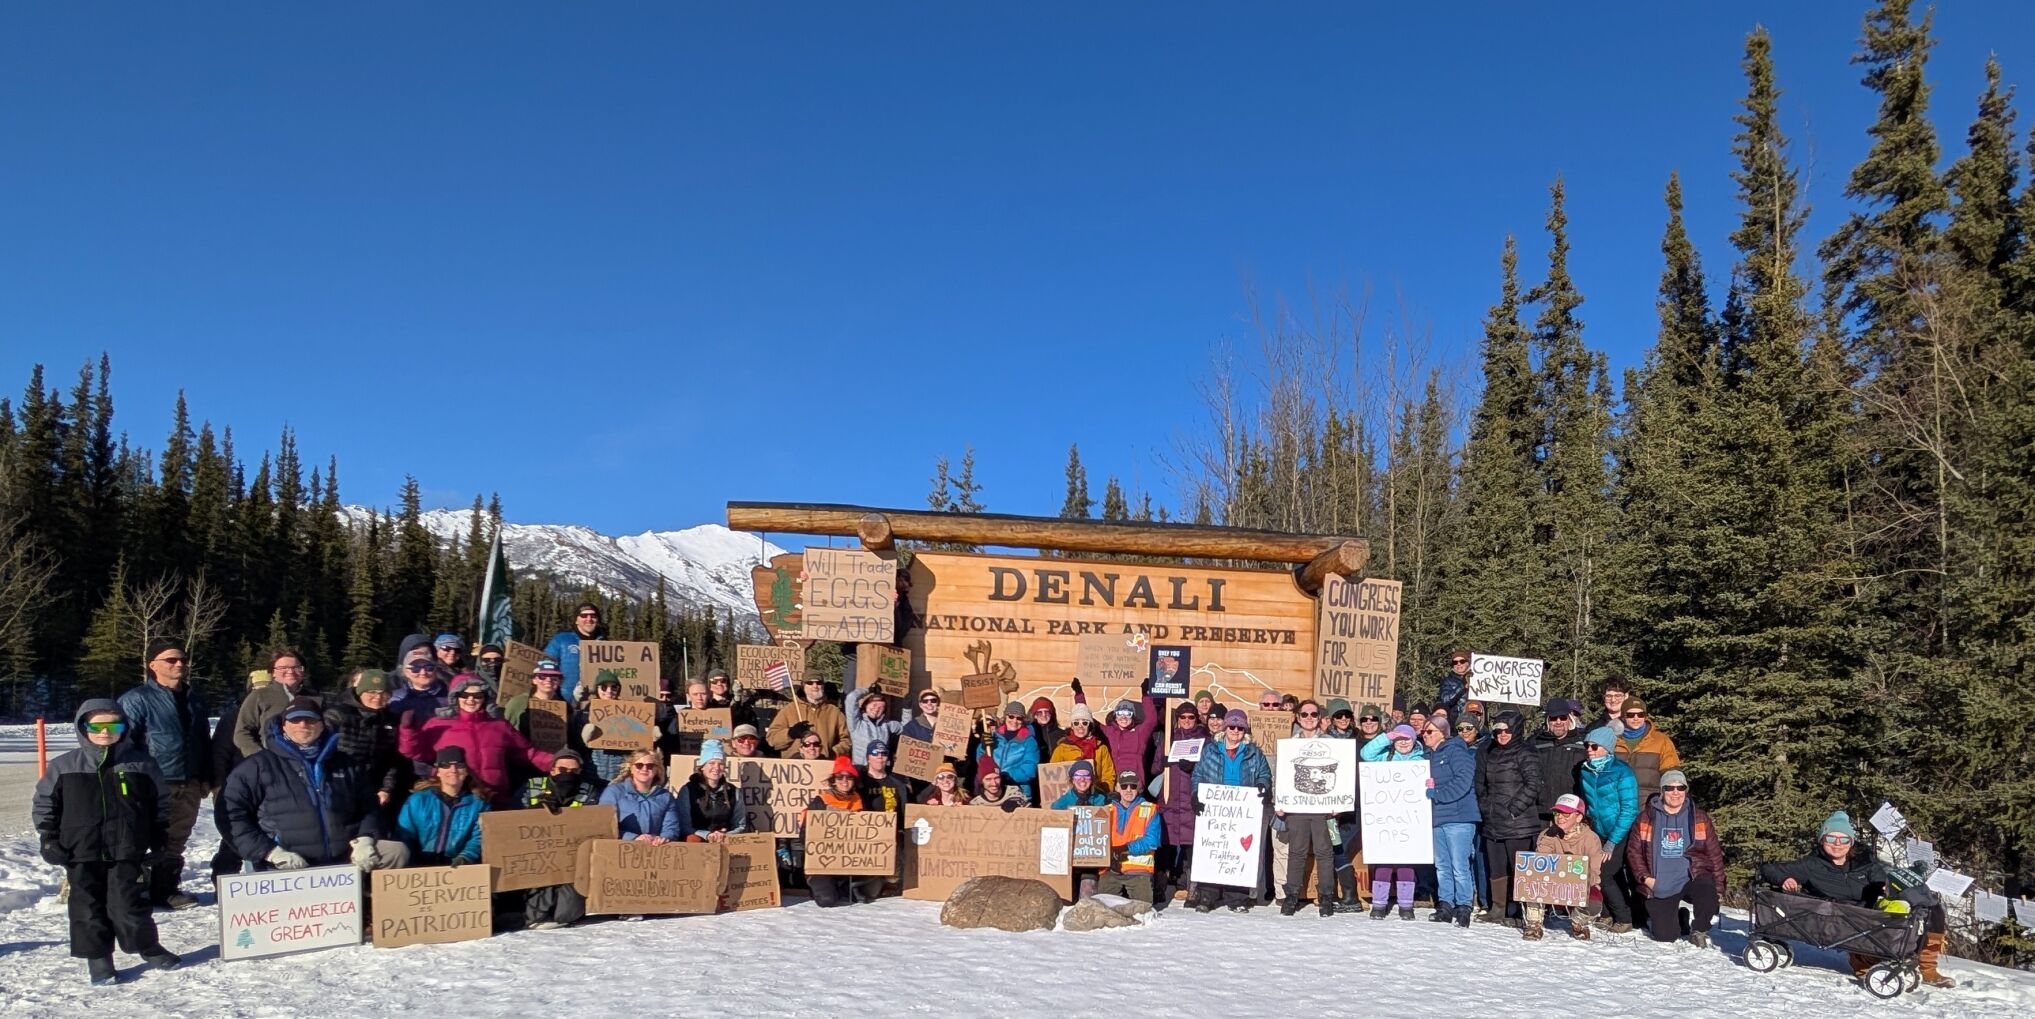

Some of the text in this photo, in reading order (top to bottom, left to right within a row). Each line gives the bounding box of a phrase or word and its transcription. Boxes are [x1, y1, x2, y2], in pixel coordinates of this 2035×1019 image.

[806, 550, 894, 577] Will Trade
[810, 577, 891, 610] EGGS
[988, 566, 1227, 612] DENALI
[1328, 580, 1400, 615] CONGRESS
[807, 614, 836, 639] For
[910, 613, 1297, 646] NATIONAL PARK AND PRESERVE
[1328, 611, 1396, 642] YOU WORK
[587, 645, 653, 663] HUG A
[740, 647, 801, 660] ECOLOGISTS
[1322, 640, 1392, 671] FOR US
[1473, 657, 1542, 677] CONGRESS
[629, 684, 649, 698] YOU
[963, 678, 995, 688] RESIST
[1320, 669, 1388, 698] NOT THE
[1470, 674, 1538, 701] WORKS 4 US
[593, 704, 654, 725] DENALI
[680, 712, 723, 728] Yesterday
[601, 740, 640, 748] FOREVER
[909, 748, 931, 760] DIES
[759, 762, 814, 786] LANDS
[904, 765, 926, 776] DOGE
[1375, 767, 1406, 784] We
[1206, 788, 1249, 802] DENALI
[1276, 794, 1354, 806] WE STAND WITH NPS
[811, 812, 896, 828] MOVE SLOW
[939, 811, 1039, 835] ONLY YOU
[1364, 808, 1421, 826] Denali
[518, 824, 567, 840] DON'T
[824, 827, 879, 841] BUILD
[1078, 834, 1109, 846] out of
[536, 838, 582, 850] BREAK
[806, 841, 893, 856] COMMUNITY
[937, 838, 968, 858] CAN
[976, 839, 1040, 858] PREVENT
[502, 850, 561, 876] FIX
[619, 843, 689, 871] POWER
[841, 855, 887, 868] DENALI
[1515, 852, 1562, 874] JOY
[643, 871, 658, 880] IN
[986, 861, 1038, 878] FIRES
[229, 873, 355, 898] PUBLIC LANDS
[383, 870, 454, 892] PUBLIC
[602, 877, 703, 899] COMMUNITY
[408, 885, 489, 907] SERVICE
[229, 901, 356, 929] MAKE AMERICA
[381, 910, 489, 938] PATRIOTIC
[270, 923, 324, 942] GREAT
